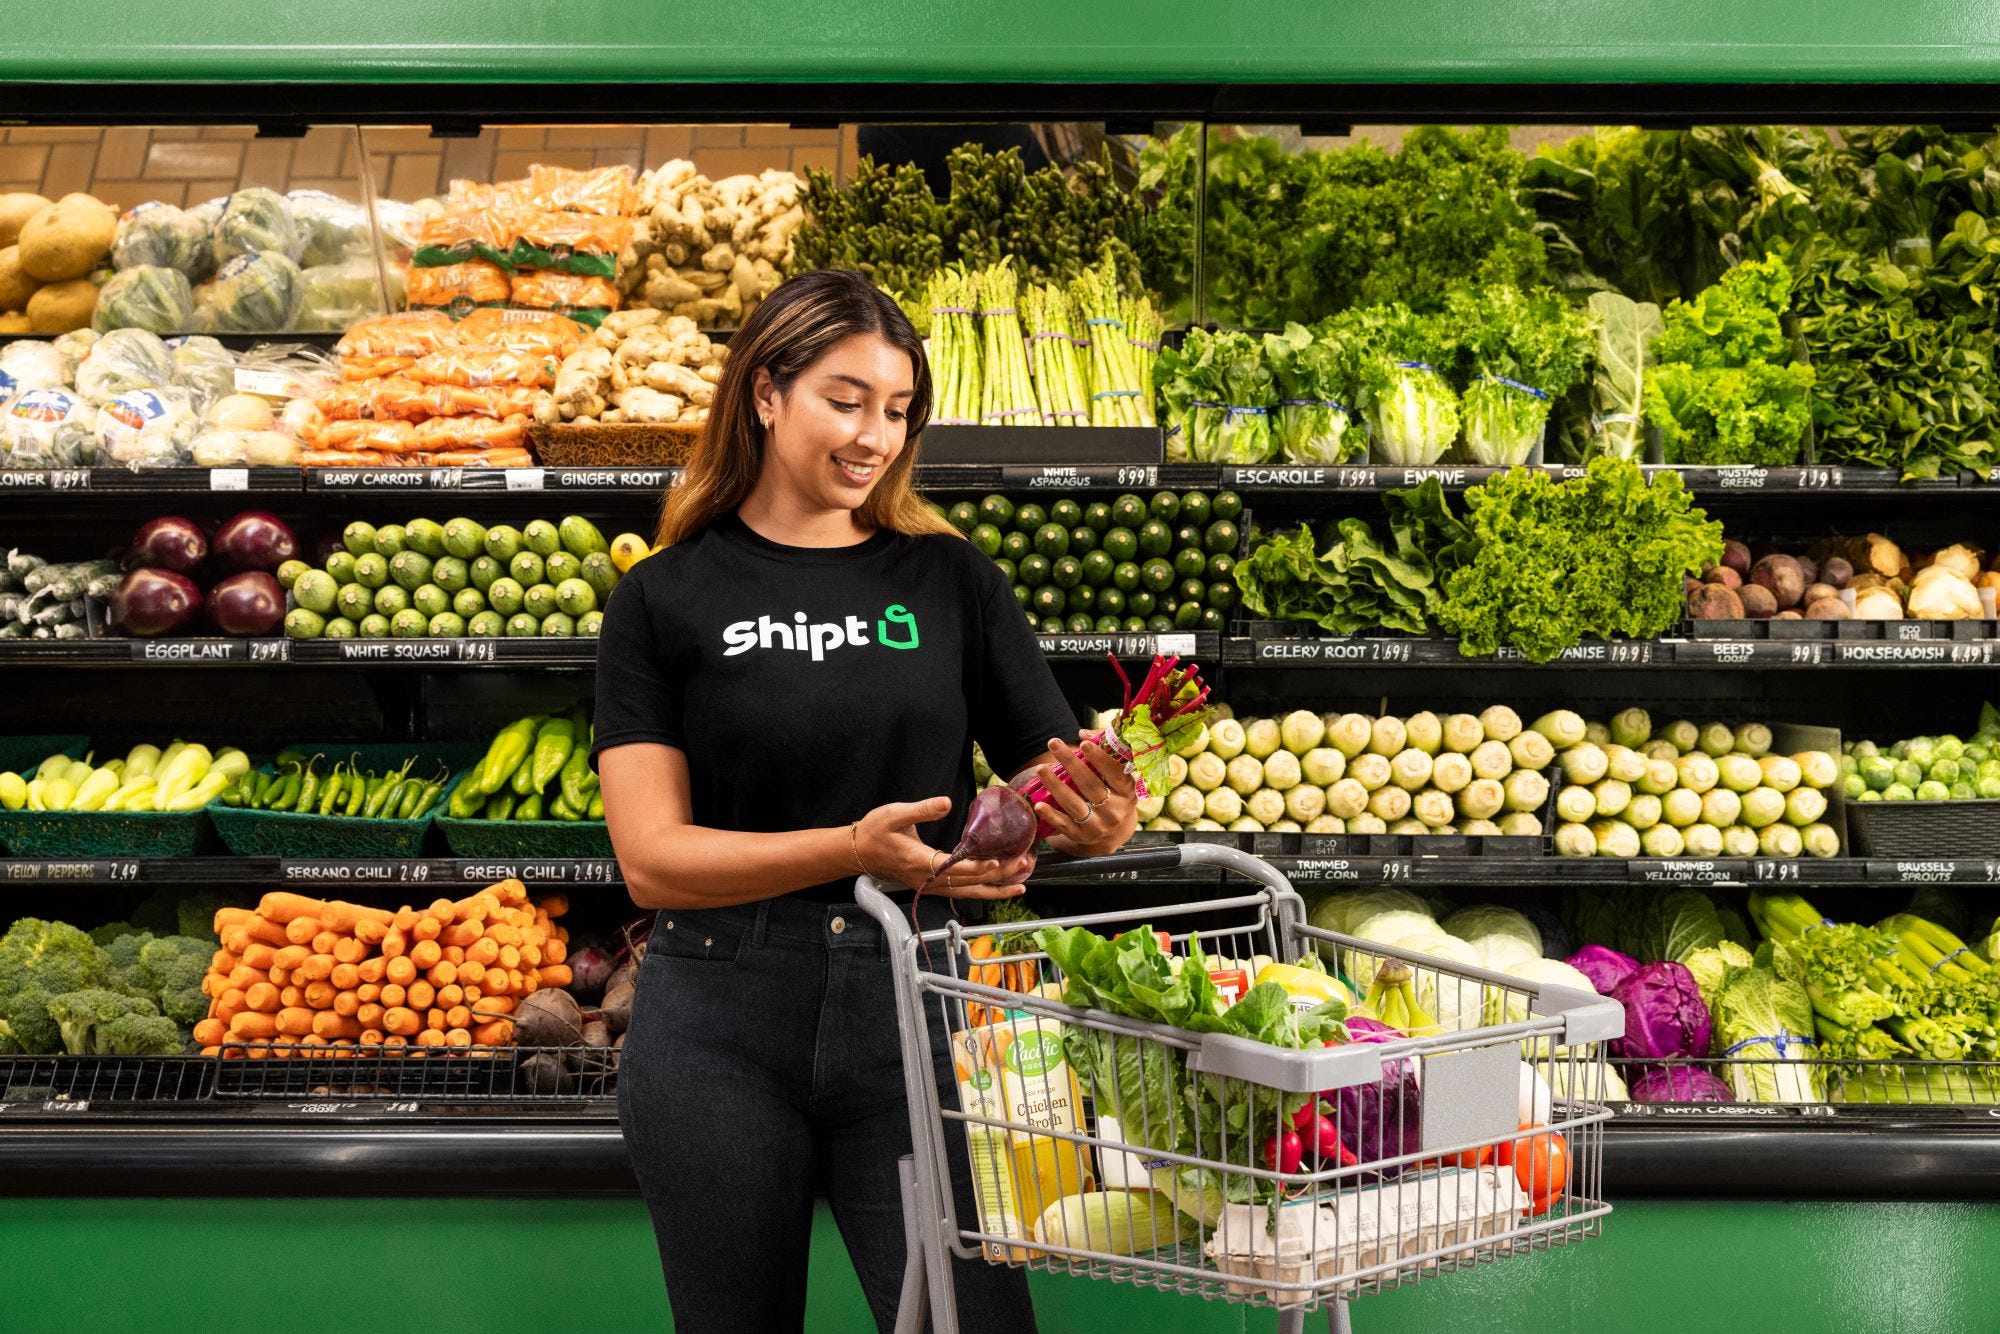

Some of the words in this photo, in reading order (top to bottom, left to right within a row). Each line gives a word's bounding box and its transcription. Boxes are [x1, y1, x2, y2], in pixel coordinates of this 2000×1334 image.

[1043, 467, 1077, 477] WHITE
[1235, 469, 1325, 484] ESCAROLE
[1717, 469, 1768, 478] MUSTARD
[0, 473, 46, 486] OWER
[324, 473, 357, 486] BABY
[364, 472, 422, 486] CARROTS
[561, 472, 616, 486] GINGER
[621, 472, 662, 486] ROOT
[1029, 477, 1090, 487] ASPARAGUS
[1720, 478, 1765, 487] GREENS
[722, 611, 870, 662] shipt
[145, 643, 233, 659] EGGPLANT
[344, 645, 389, 658] WHITE
[394, 645, 449, 659] SQUASH
[1060, 639, 1111, 654] SQUASH
[1262, 645, 1320, 658] CELERY
[1325, 645, 1367, 658] ROOT
[1713, 643, 1754, 655] BEETS
[1843, 646, 1944, 660] HORSERADISH
[1717, 655, 1750, 663] LOOSE
[1315, 839, 1337, 848] IFCO
[6, 864, 40, 879] YELLOW
[47, 863, 94, 878] PEPPERS
[1297, 860, 1349, 870] TRIMMED
[1661, 861, 1714, 872] TRIMMED
[1897, 862, 1955, 872] BRUSSELS
[286, 866, 349, 879] SERRANO
[354, 866, 391, 880] CHILI
[463, 866, 516, 880] GREEN
[523, 865, 565, 880] CHILI
[1287, 870, 1321, 879] WHITE
[1325, 870, 1359, 879] CORN
[1645, 871, 1692, 881] YELLOW
[1696, 871, 1730, 881] CORN
[1901, 872, 1952, 882] SPROUTS
[1009, 1037, 1059, 1066] Pacific
